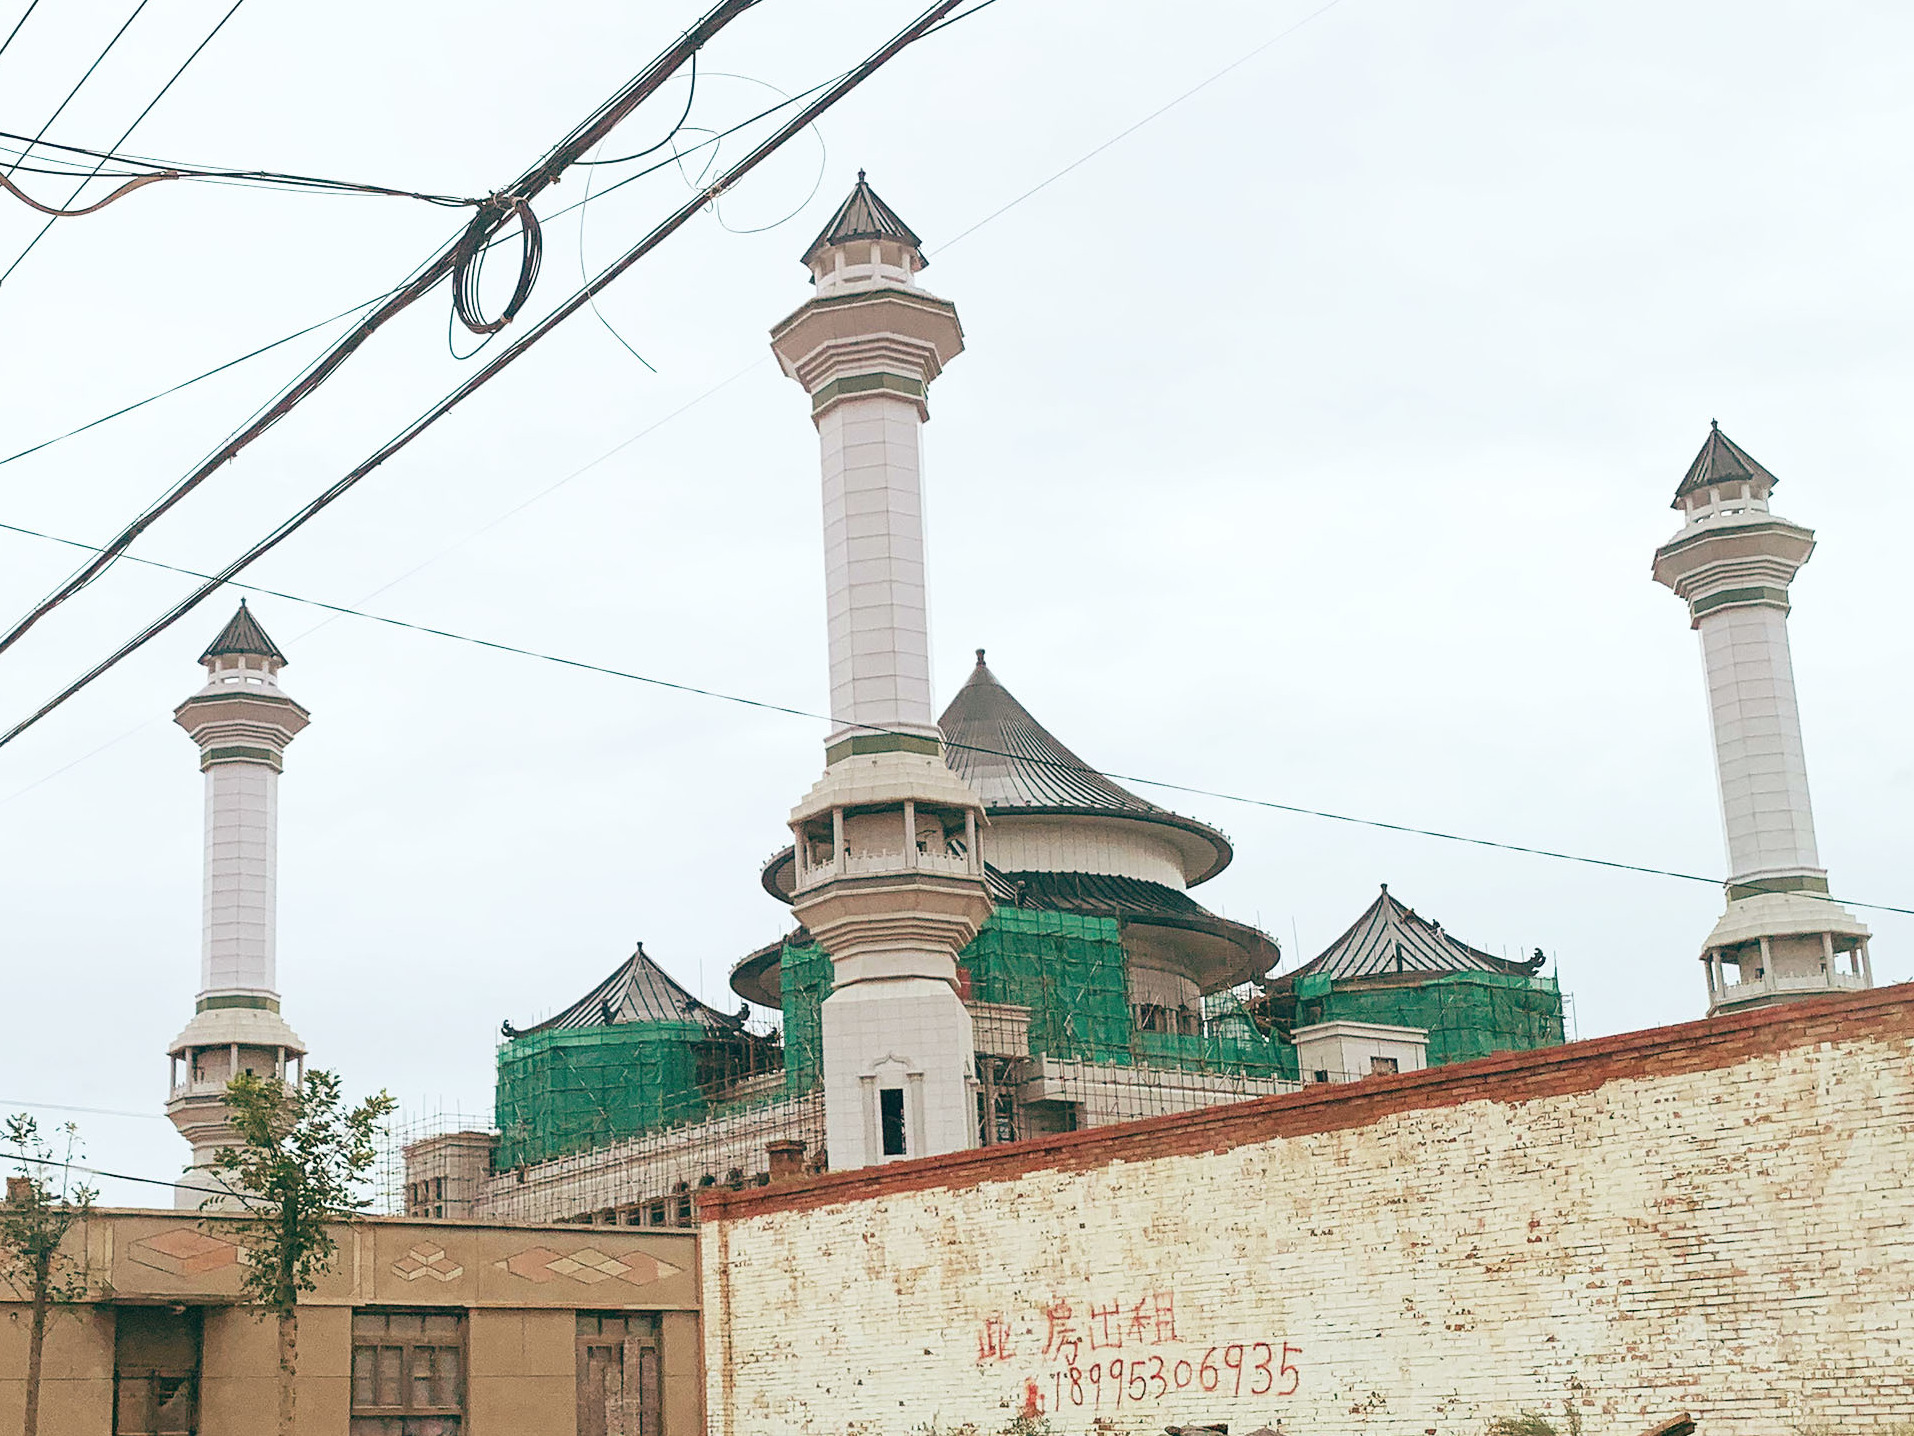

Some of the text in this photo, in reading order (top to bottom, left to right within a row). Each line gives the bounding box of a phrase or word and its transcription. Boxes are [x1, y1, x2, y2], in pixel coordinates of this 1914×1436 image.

[977, 1287, 1184, 1365] 此房出租
[1054, 1341, 1303, 1412] 18995306935
